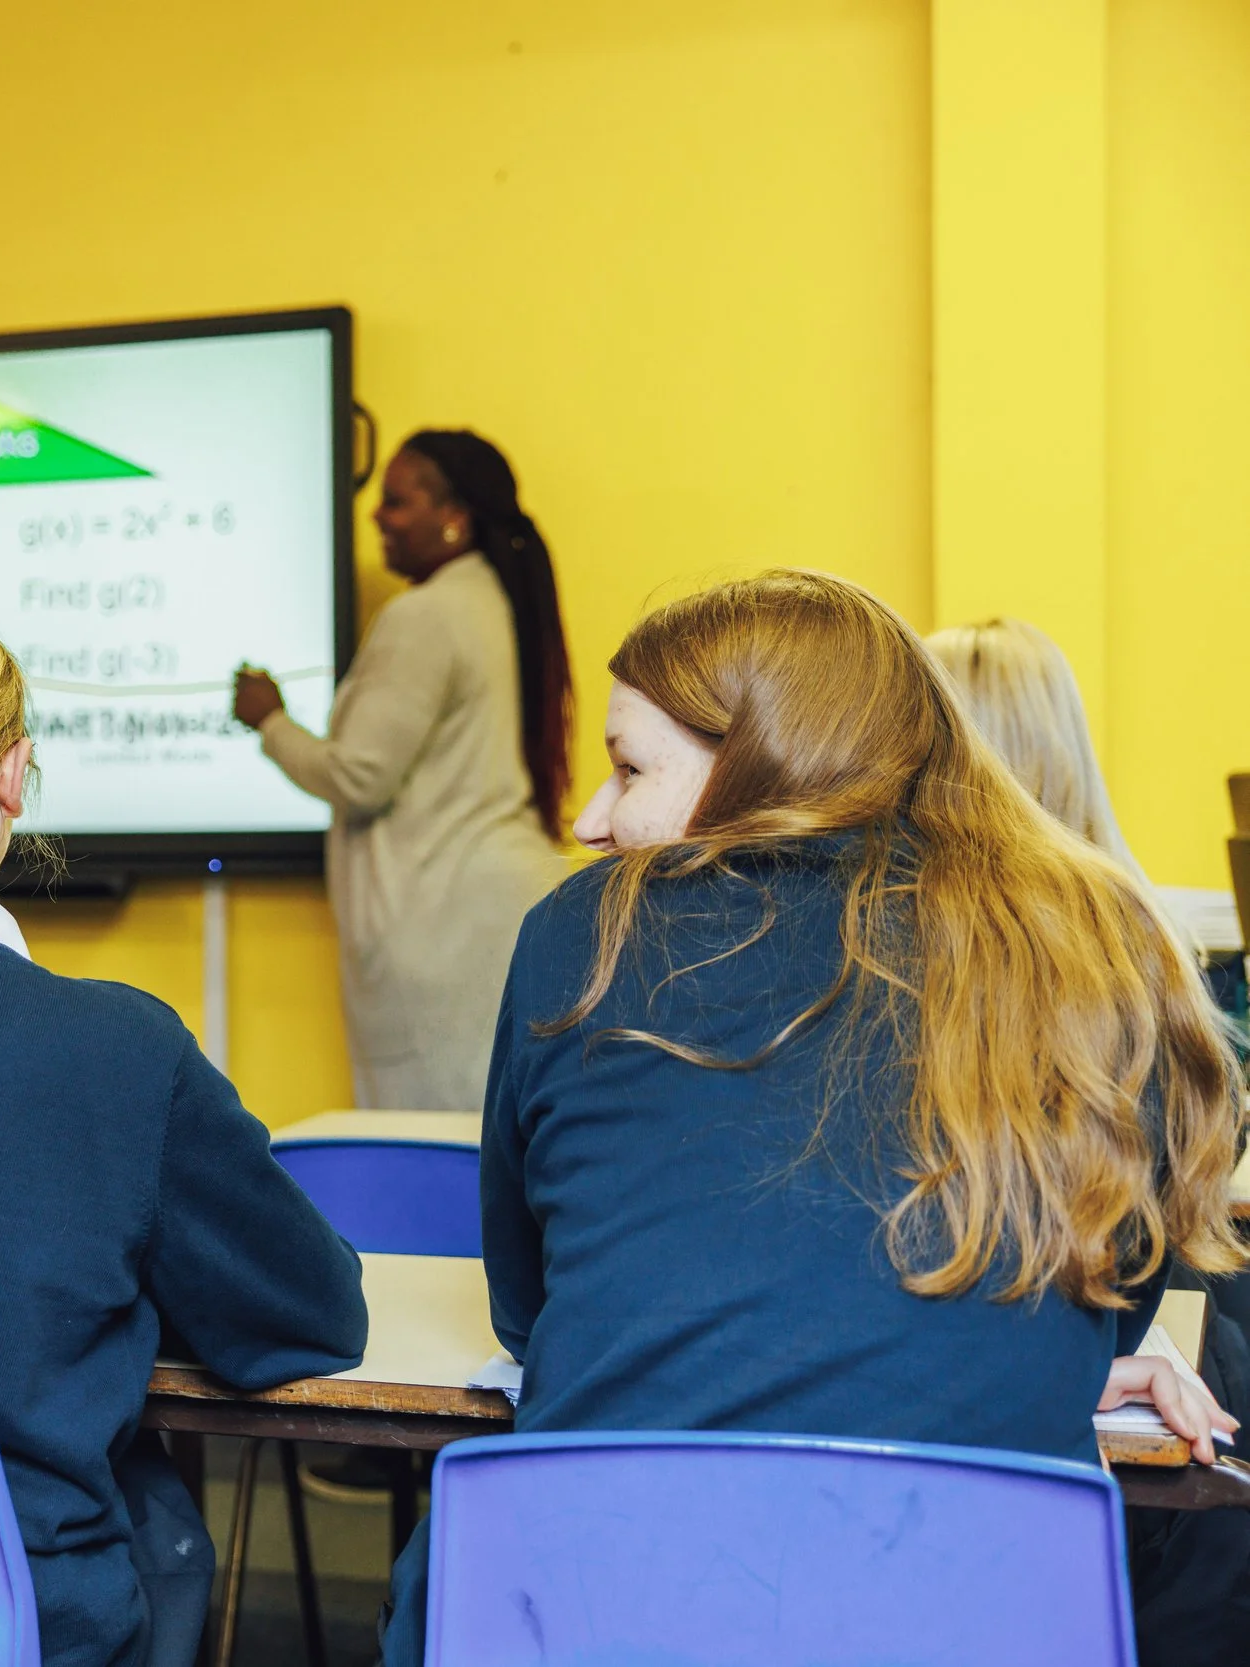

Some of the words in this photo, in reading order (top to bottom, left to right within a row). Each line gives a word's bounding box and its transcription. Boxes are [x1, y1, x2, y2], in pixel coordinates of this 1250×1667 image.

[212, 501, 235, 535] 6
[20, 578, 91, 611] Find
[97, 574, 166, 617] g(2)
[21, 643, 91, 677] Find
[97, 642, 179, 682] g(-3)
